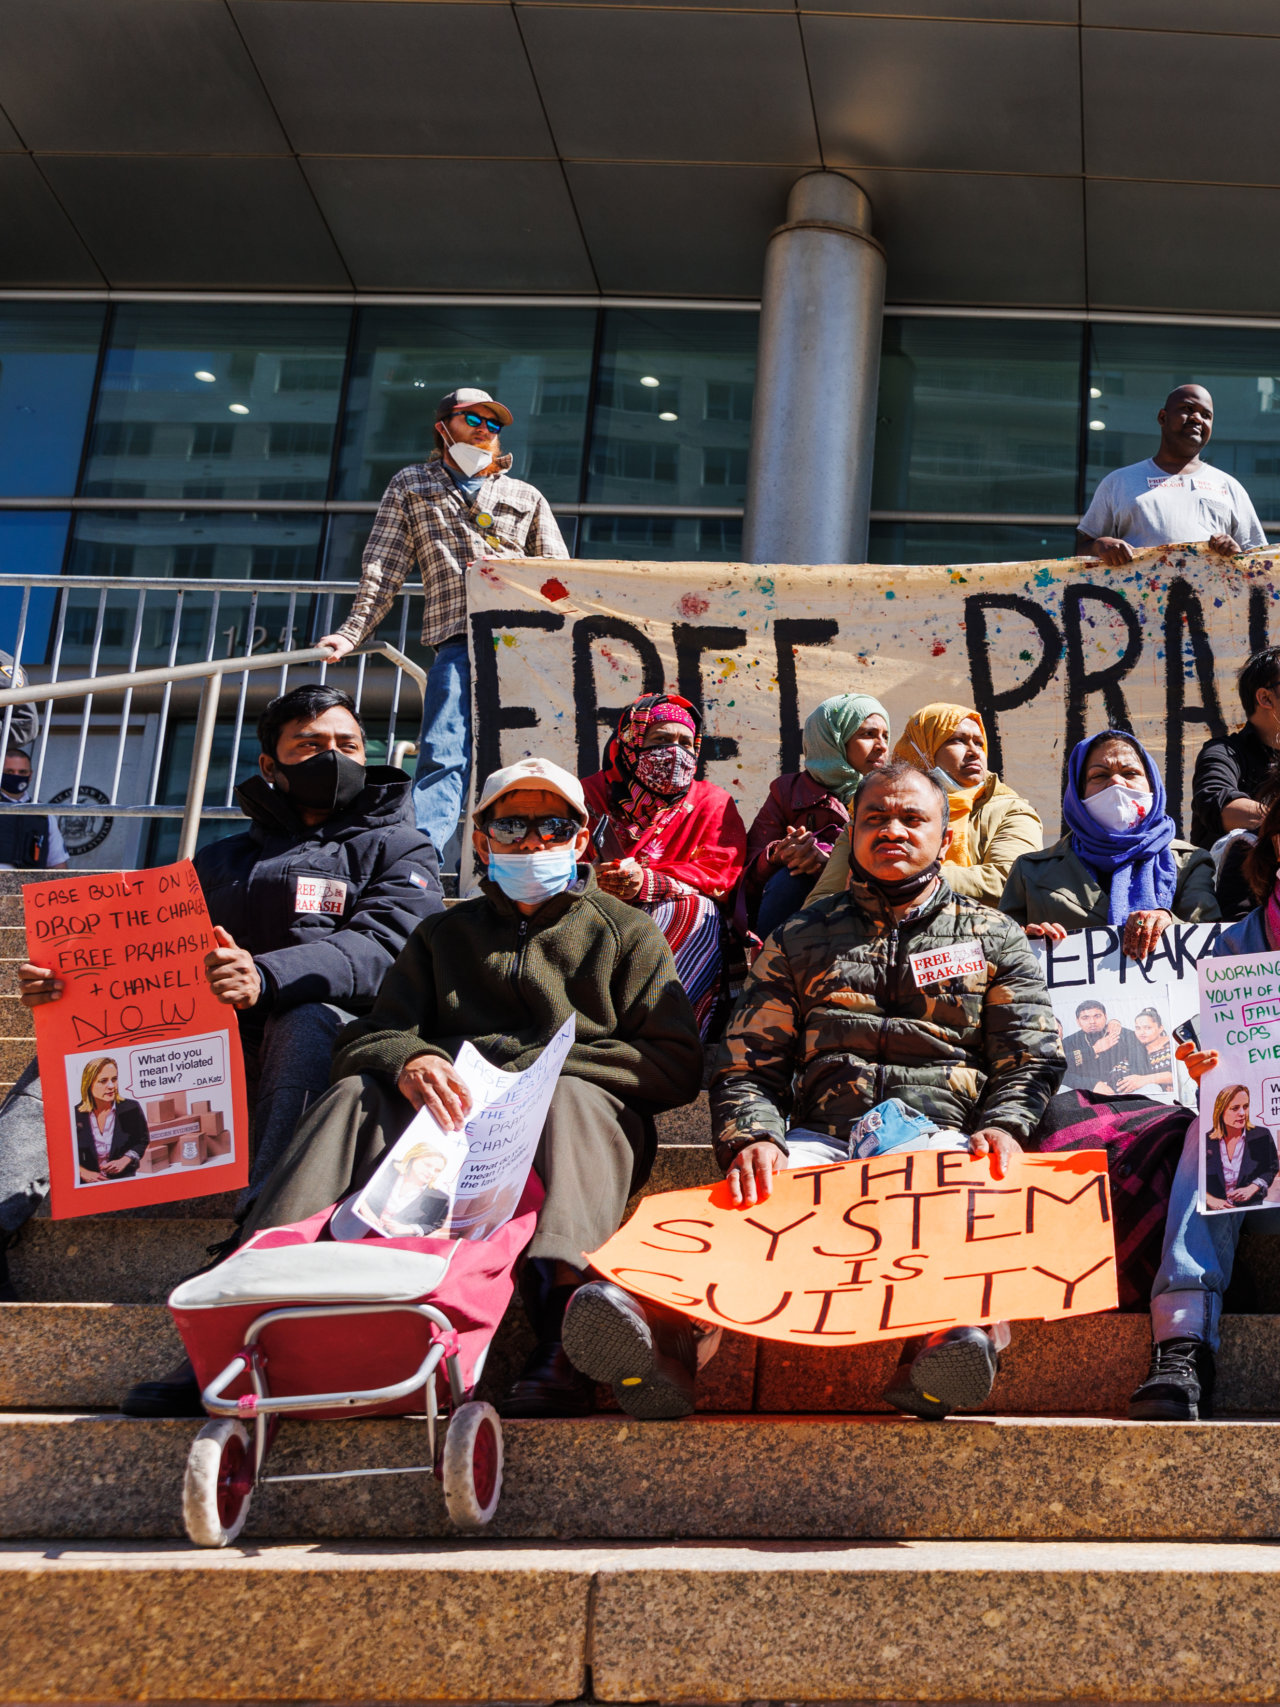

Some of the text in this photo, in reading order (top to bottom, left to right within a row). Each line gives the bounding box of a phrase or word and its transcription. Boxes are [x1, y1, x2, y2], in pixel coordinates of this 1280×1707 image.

[35, 888, 80, 908] CASE
[89, 880, 144, 902] BUILT
[159, 872, 180, 893] ON
[35, 913, 100, 939] DROP
[109, 910, 152, 928] THE
[59, 933, 209, 969] FREE PRAKASH
[914, 950, 952, 972] FREE
[917, 959, 985, 985] PRAKASH
[1206, 987, 1253, 1004] YOUTH
[1257, 985, 1273, 997] OF
[72, 998, 195, 1041] NOW
[1214, 1010, 1234, 1023] IN
[1226, 1026, 1271, 1045] COPS
[138, 1048, 202, 1066] What do you
[465, 1049, 511, 1088] CASE
[553, 1023, 571, 1053] ON
[139, 1065, 168, 1078] mean
[176, 1056, 213, 1071] violated
[140, 1073, 182, 1088] the law?
[196, 1078, 208, 1086] DA
[209, 1075, 222, 1084] Katz
[480, 1110, 505, 1119] THE
[464, 1170, 495, 1181] mean
[470, 1161, 498, 1172] What
[460, 1181, 479, 1189] the
[793, 1151, 986, 1206] THE
[640, 1174, 1111, 1262] SYSTEM
[837, 1254, 930, 1287] IS
[610, 1256, 1114, 1336] GUILTY
